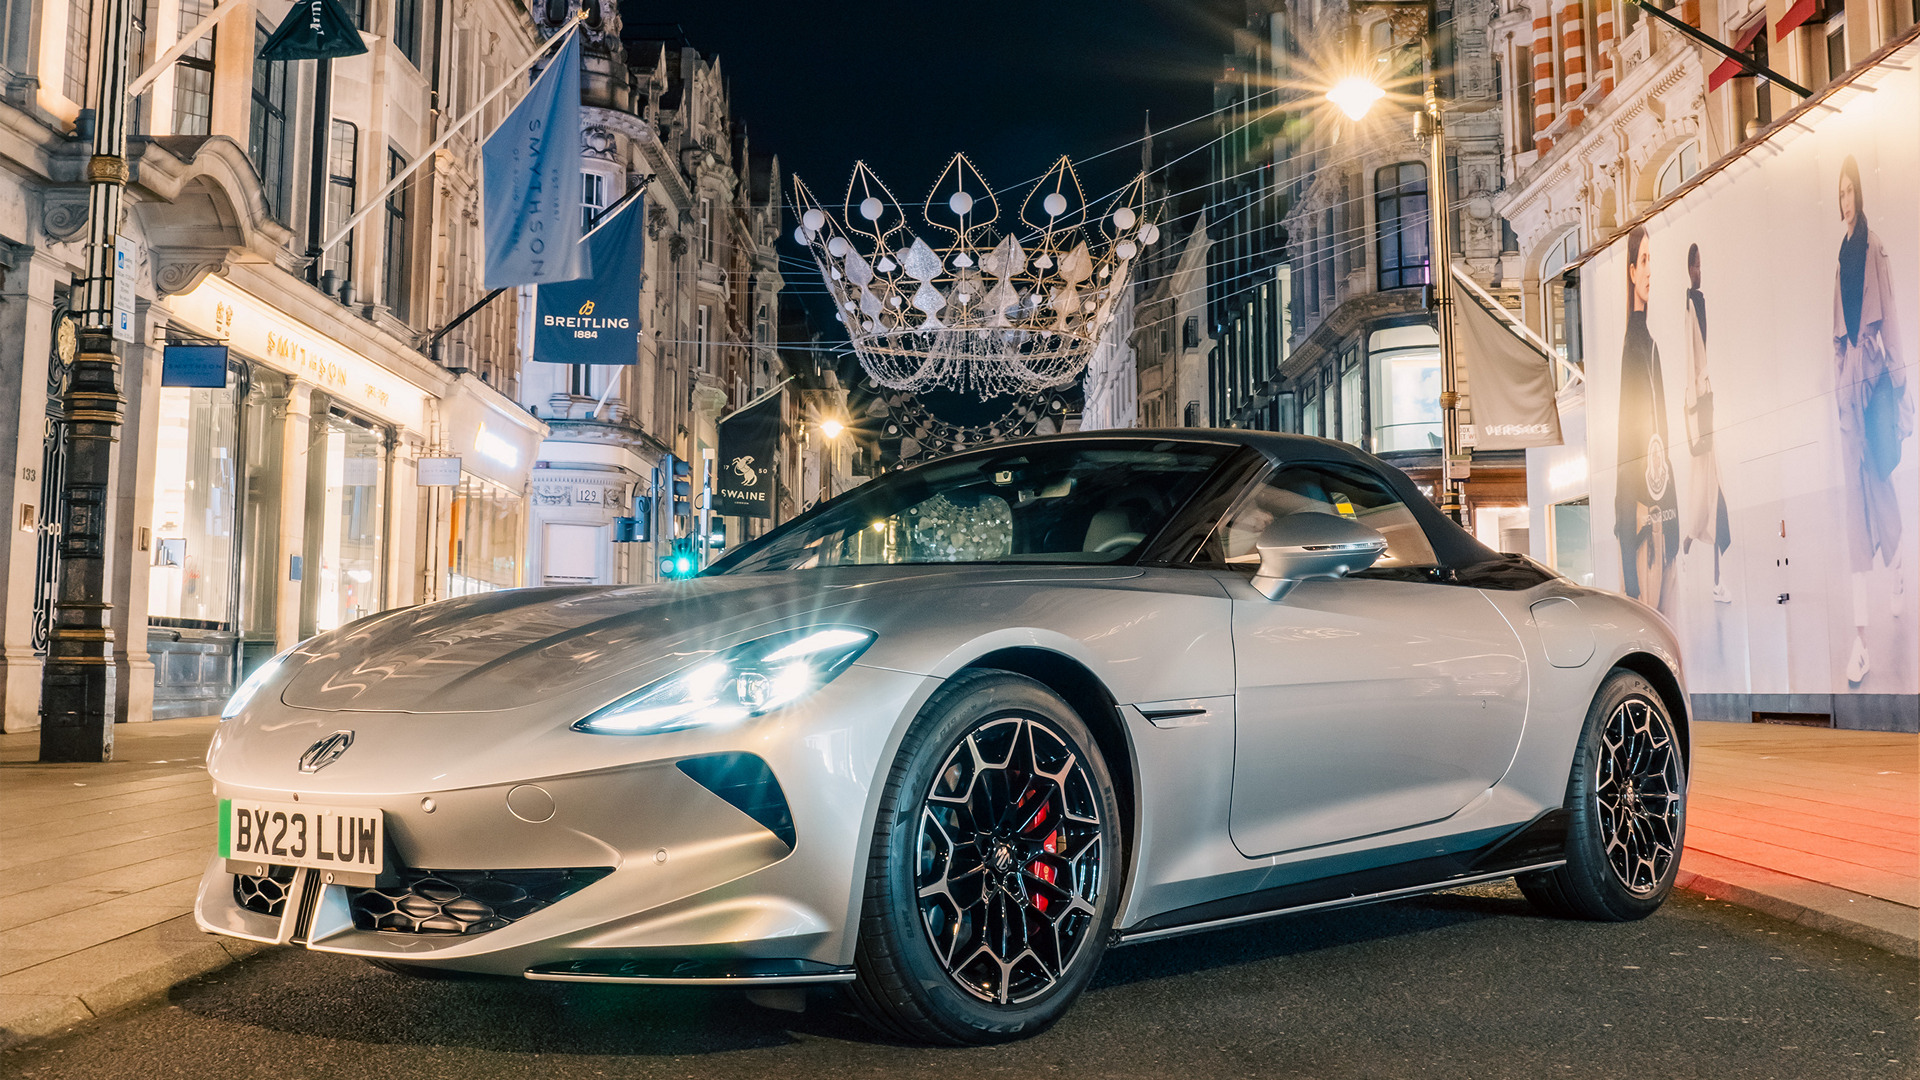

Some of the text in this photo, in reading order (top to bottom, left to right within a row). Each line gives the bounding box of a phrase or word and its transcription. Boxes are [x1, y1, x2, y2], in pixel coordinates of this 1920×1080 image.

[529, 119, 545, 277] SMYTHSON
[544, 315, 630, 329] BREITLING
[574, 330, 598, 339] 1884
[1485, 423, 1550, 436] VERSACE
[22, 467, 36, 481] 133
[580, 489, 597, 501] 129
[721, 489, 766, 501] SWAINE
[301, 732, 352, 771] MG
[236, 808, 376, 865] BX23 LUW
